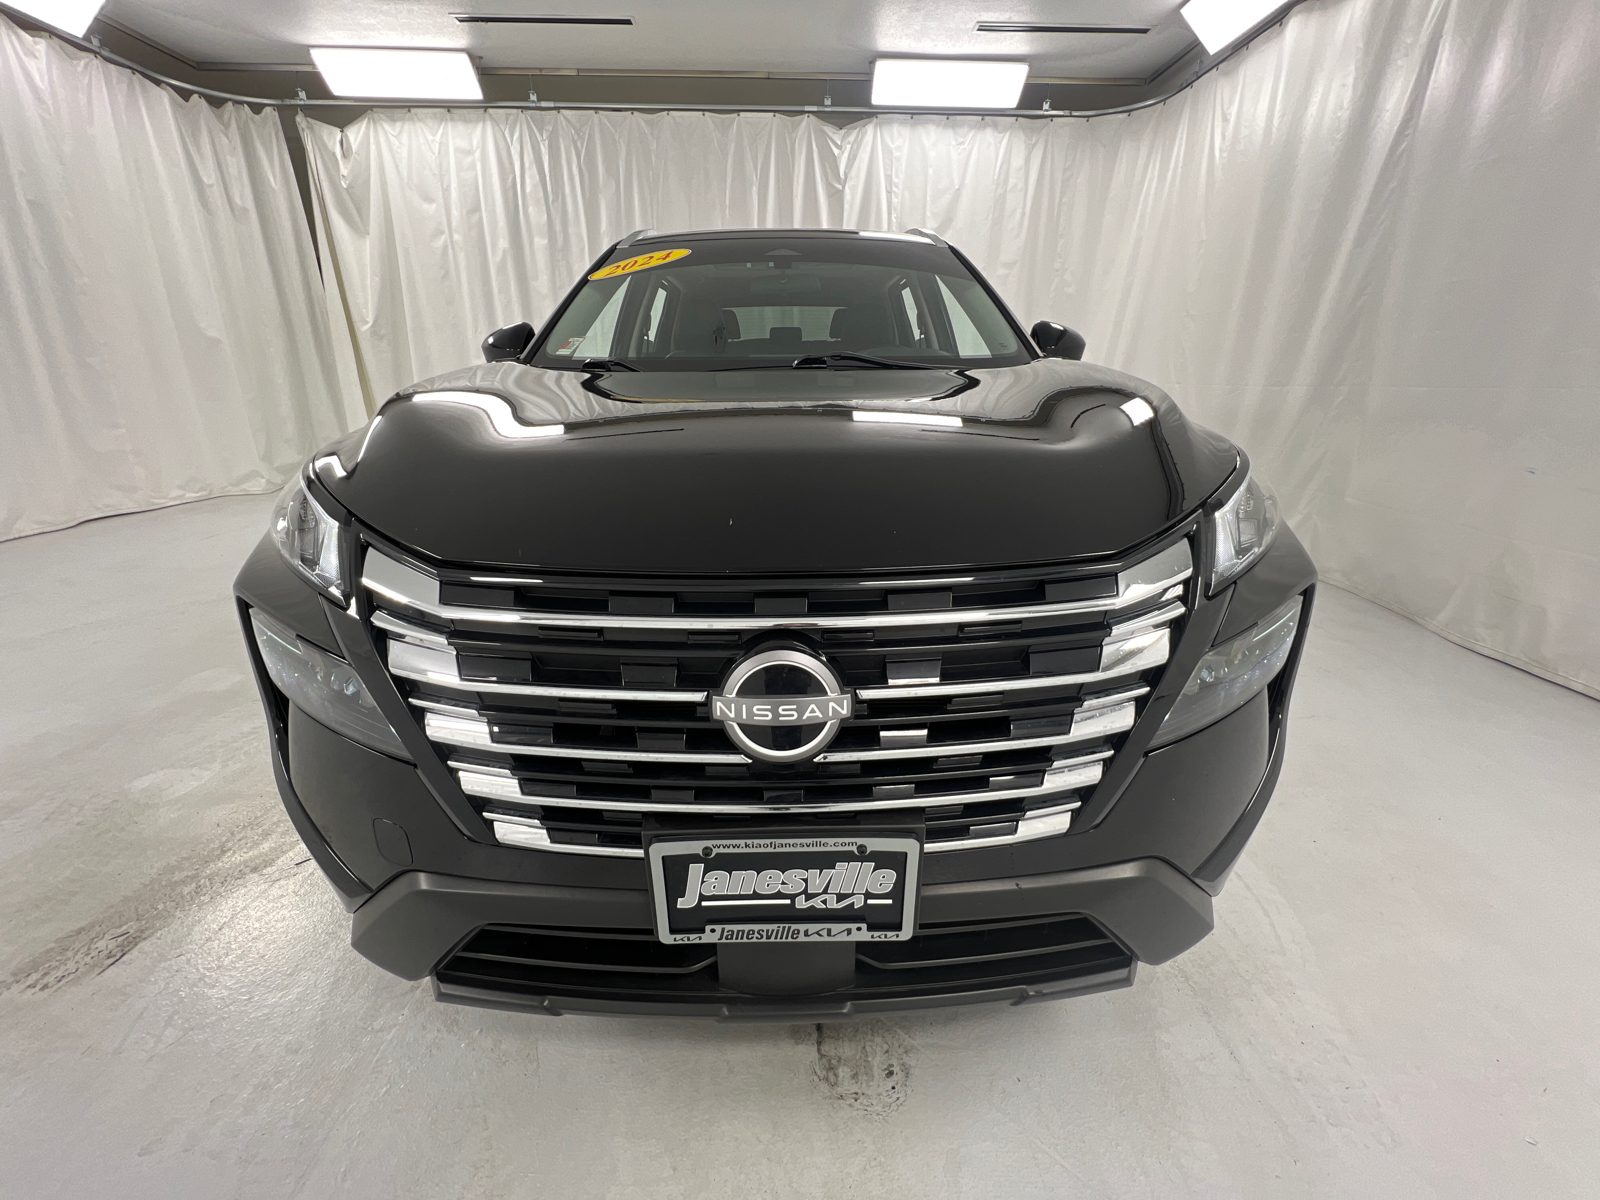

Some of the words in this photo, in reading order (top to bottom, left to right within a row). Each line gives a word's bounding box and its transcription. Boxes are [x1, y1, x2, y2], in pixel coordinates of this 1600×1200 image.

[604, 250, 674, 277] 2024
[716, 700, 847, 720] NISSAN
[711, 840, 858, 849] www.kiaofjanesville.com
[676, 862, 897, 908] Janesville
[795, 894, 865, 909] KIA
[717, 925, 800, 941] Janesville
[803, 927, 852, 938] KIA
